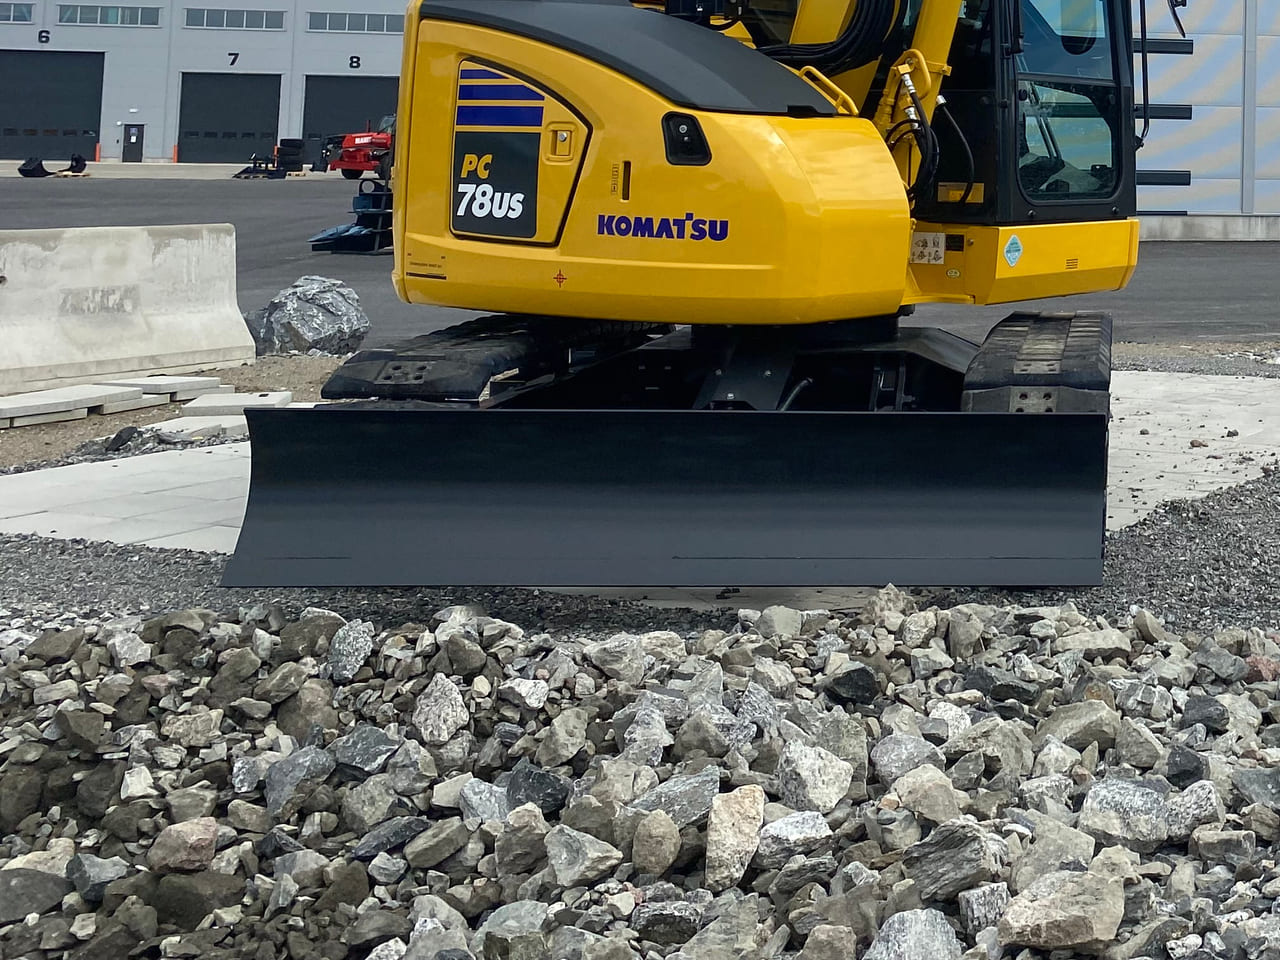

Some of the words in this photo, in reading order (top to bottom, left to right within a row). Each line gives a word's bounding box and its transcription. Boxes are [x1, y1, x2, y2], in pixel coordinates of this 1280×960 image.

[38, 30, 51, 44] 6
[228, 53, 239, 66] 7
[349, 56, 361, 69] 8
[460, 153, 493, 179] PC
[456, 183, 525, 219] 78US
[597, 212, 729, 241] KOMATSU
